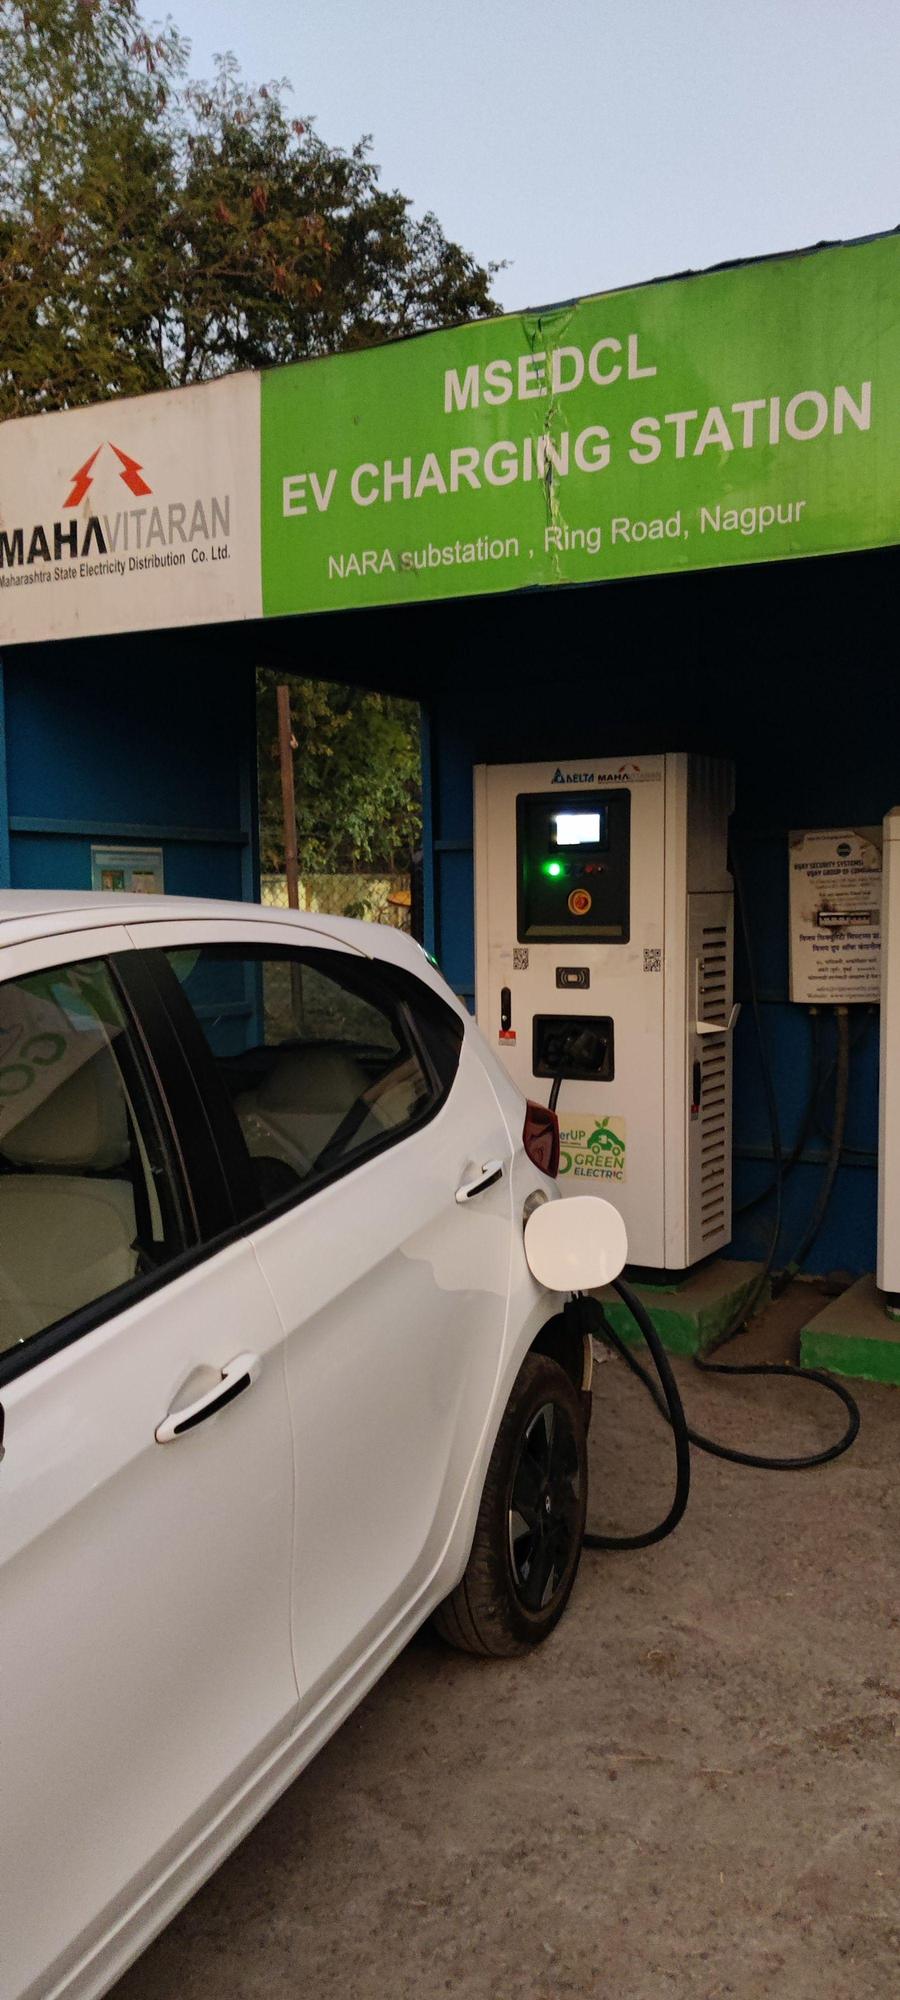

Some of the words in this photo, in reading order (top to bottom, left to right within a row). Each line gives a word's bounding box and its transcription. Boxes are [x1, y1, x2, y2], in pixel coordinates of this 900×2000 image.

[444, 334, 657, 414] MSEDCL
[283, 469, 338, 517] EV
[350, 425, 611, 508] CHARGING
[629, 381, 873, 466] STATION
[0, 495, 231, 568] MAHAVITARAN
[54, 567, 78, 582] State
[79, 558, 126, 578] Electricity
[128, 551, 186, 571] Distribution
[191, 547, 209, 563] Co.
[211, 543, 231, 561] Ltd.
[328, 548, 396, 579] NARA
[402, 535, 519, 571] substation
[543, 525, 601, 555] Ring
[611, 510, 689, 544] Road,
[700, 500, 806, 535] Nagpur
[574, 1153, 625, 1169] GREEN
[574, 1167, 623, 1180] ELECTRIC
